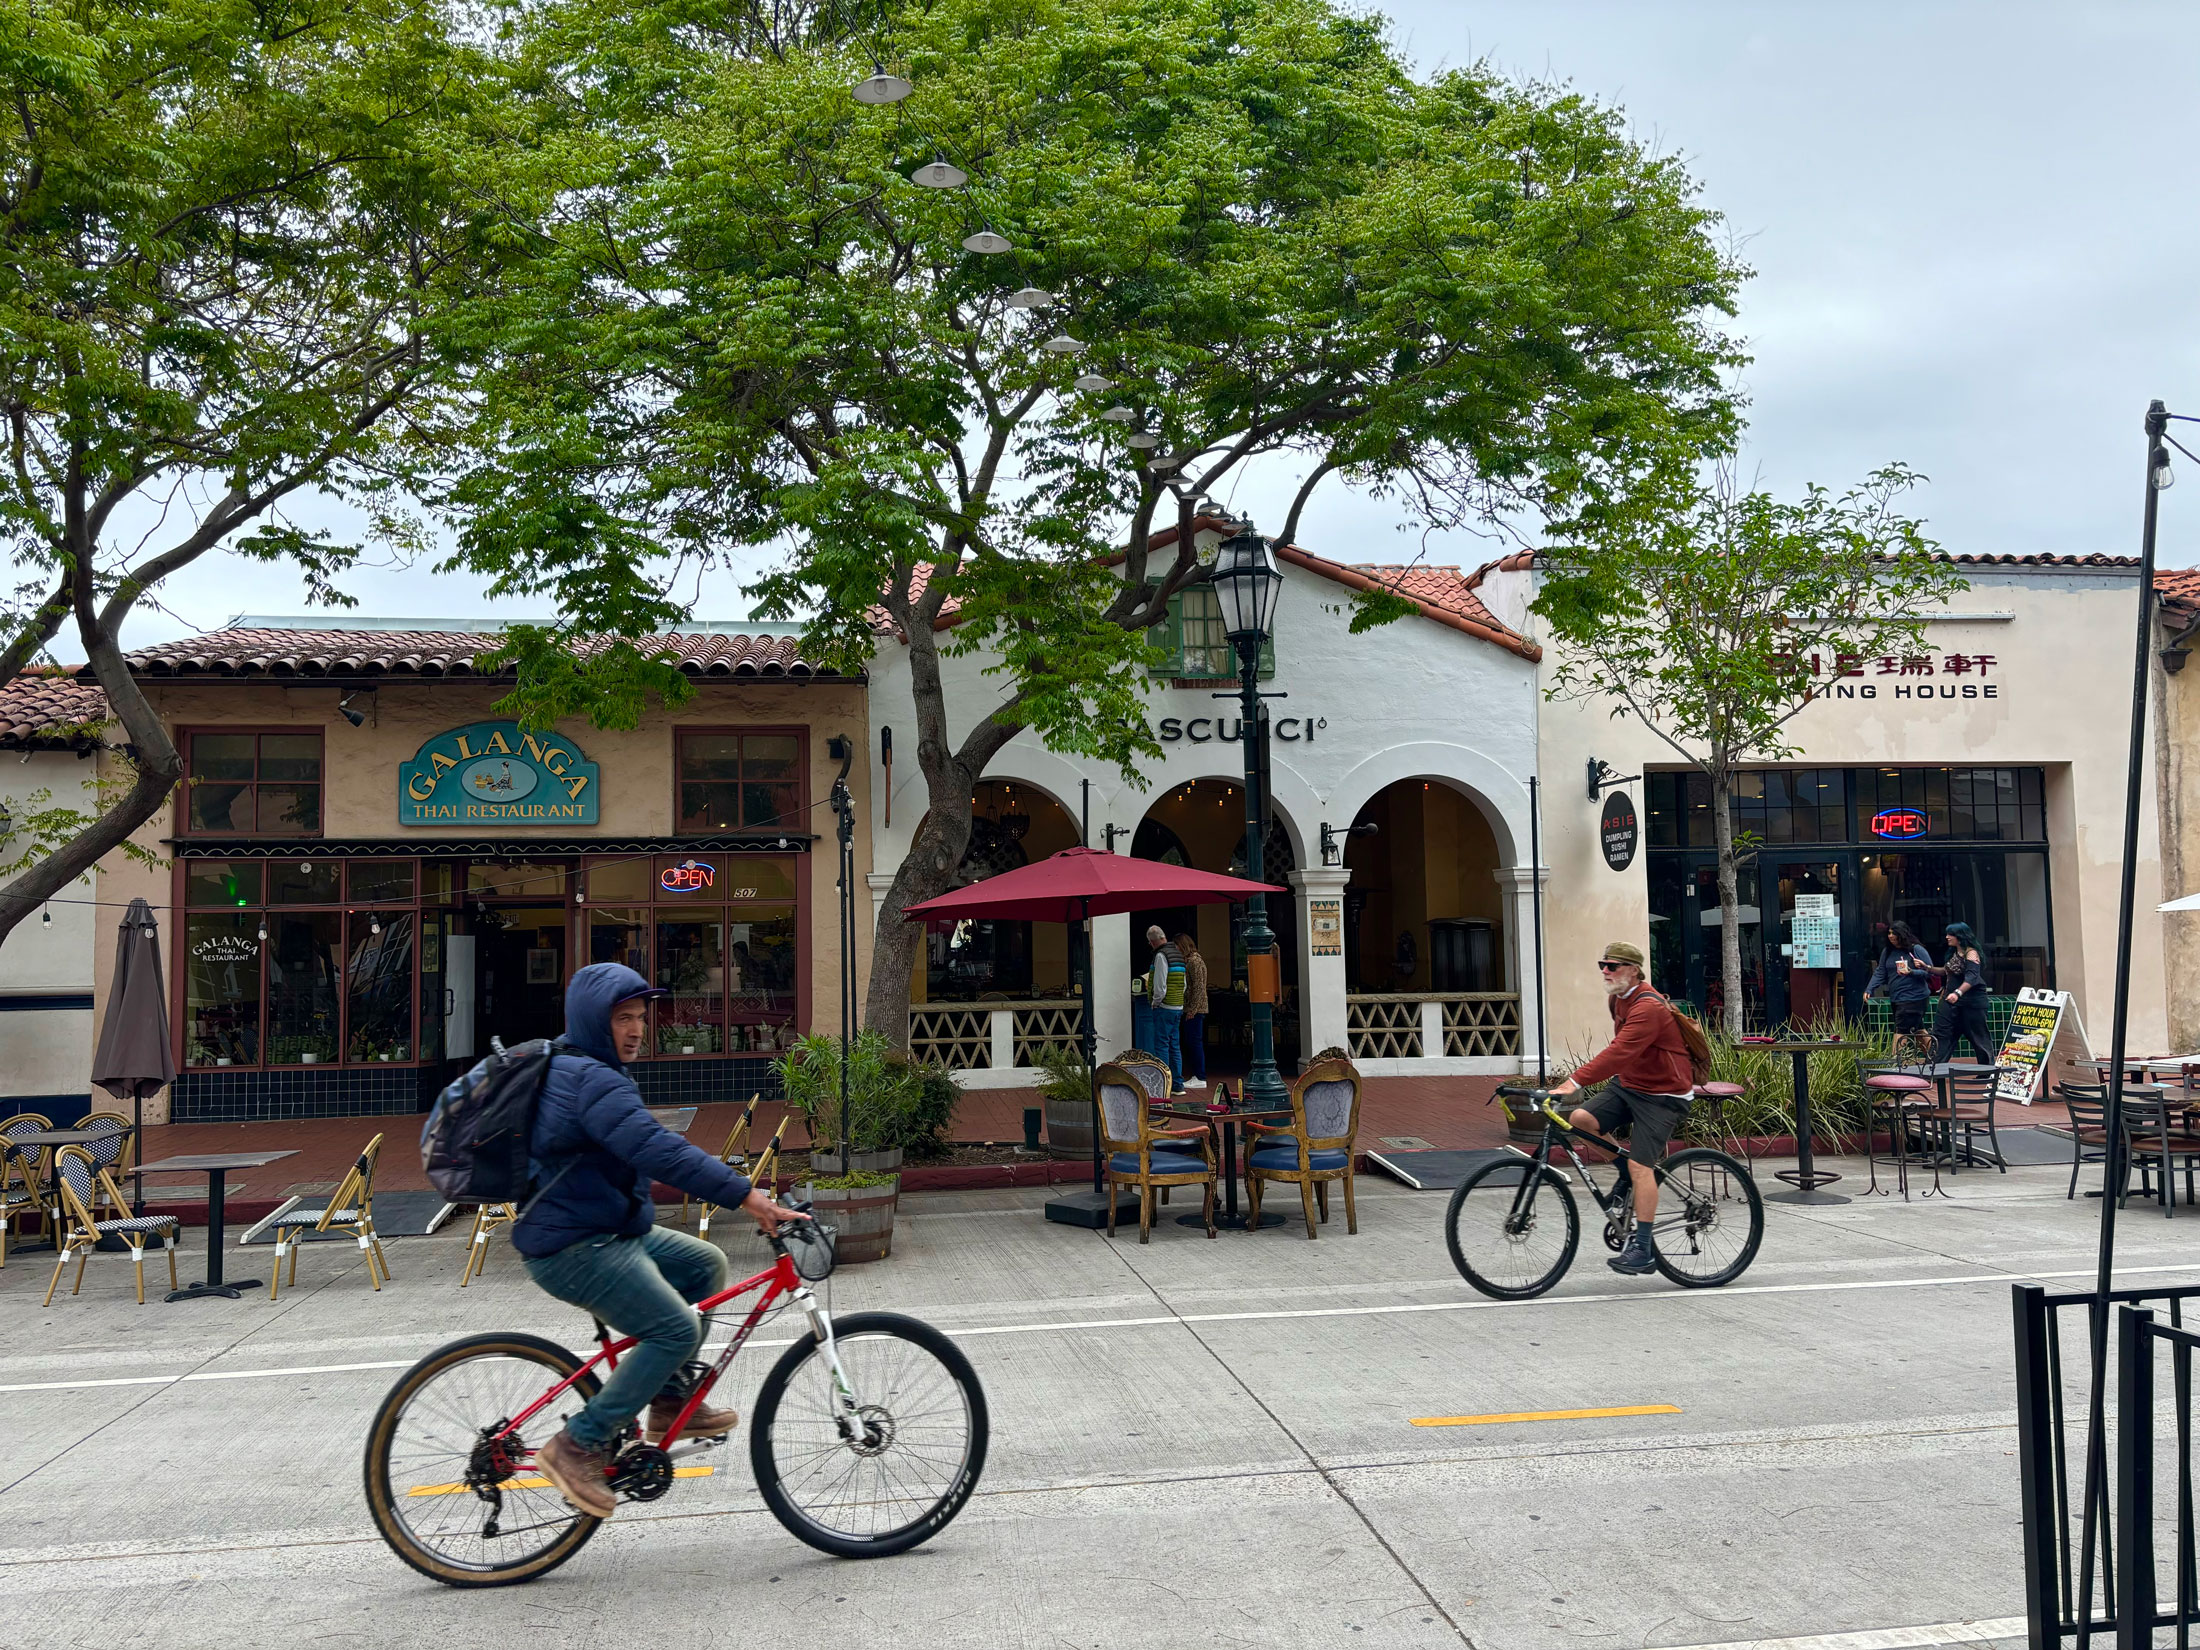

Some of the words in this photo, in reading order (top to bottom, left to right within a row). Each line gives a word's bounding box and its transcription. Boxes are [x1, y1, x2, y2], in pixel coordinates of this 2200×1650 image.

[1895, 685, 1998, 698] HOUSE
[1115, 718, 1315, 742] ASCUCI
[408, 731, 589, 801] GALANGA
[413, 805, 457, 818] THAI
[467, 804, 585, 818] RESTAURANT
[1603, 814, 1634, 830] ASIE
[1872, 815, 1932, 833] OPEN
[1605, 830, 1632, 843] DUMPLING
[1611, 842, 1627, 852] SUSHI
[1610, 851, 1629, 862] RAMEN
[661, 868, 714, 887] OPEN
[734, 889, 757, 897] 507
[192, 936, 258, 956] GALANGA
[2017, 1005, 2037, 1016] HAPPY
[2038, 1008, 2056, 1018] HOUR
[2012, 1015, 2021, 1024] 12
[2021, 1016, 2055, 1029] NOON-6PM
